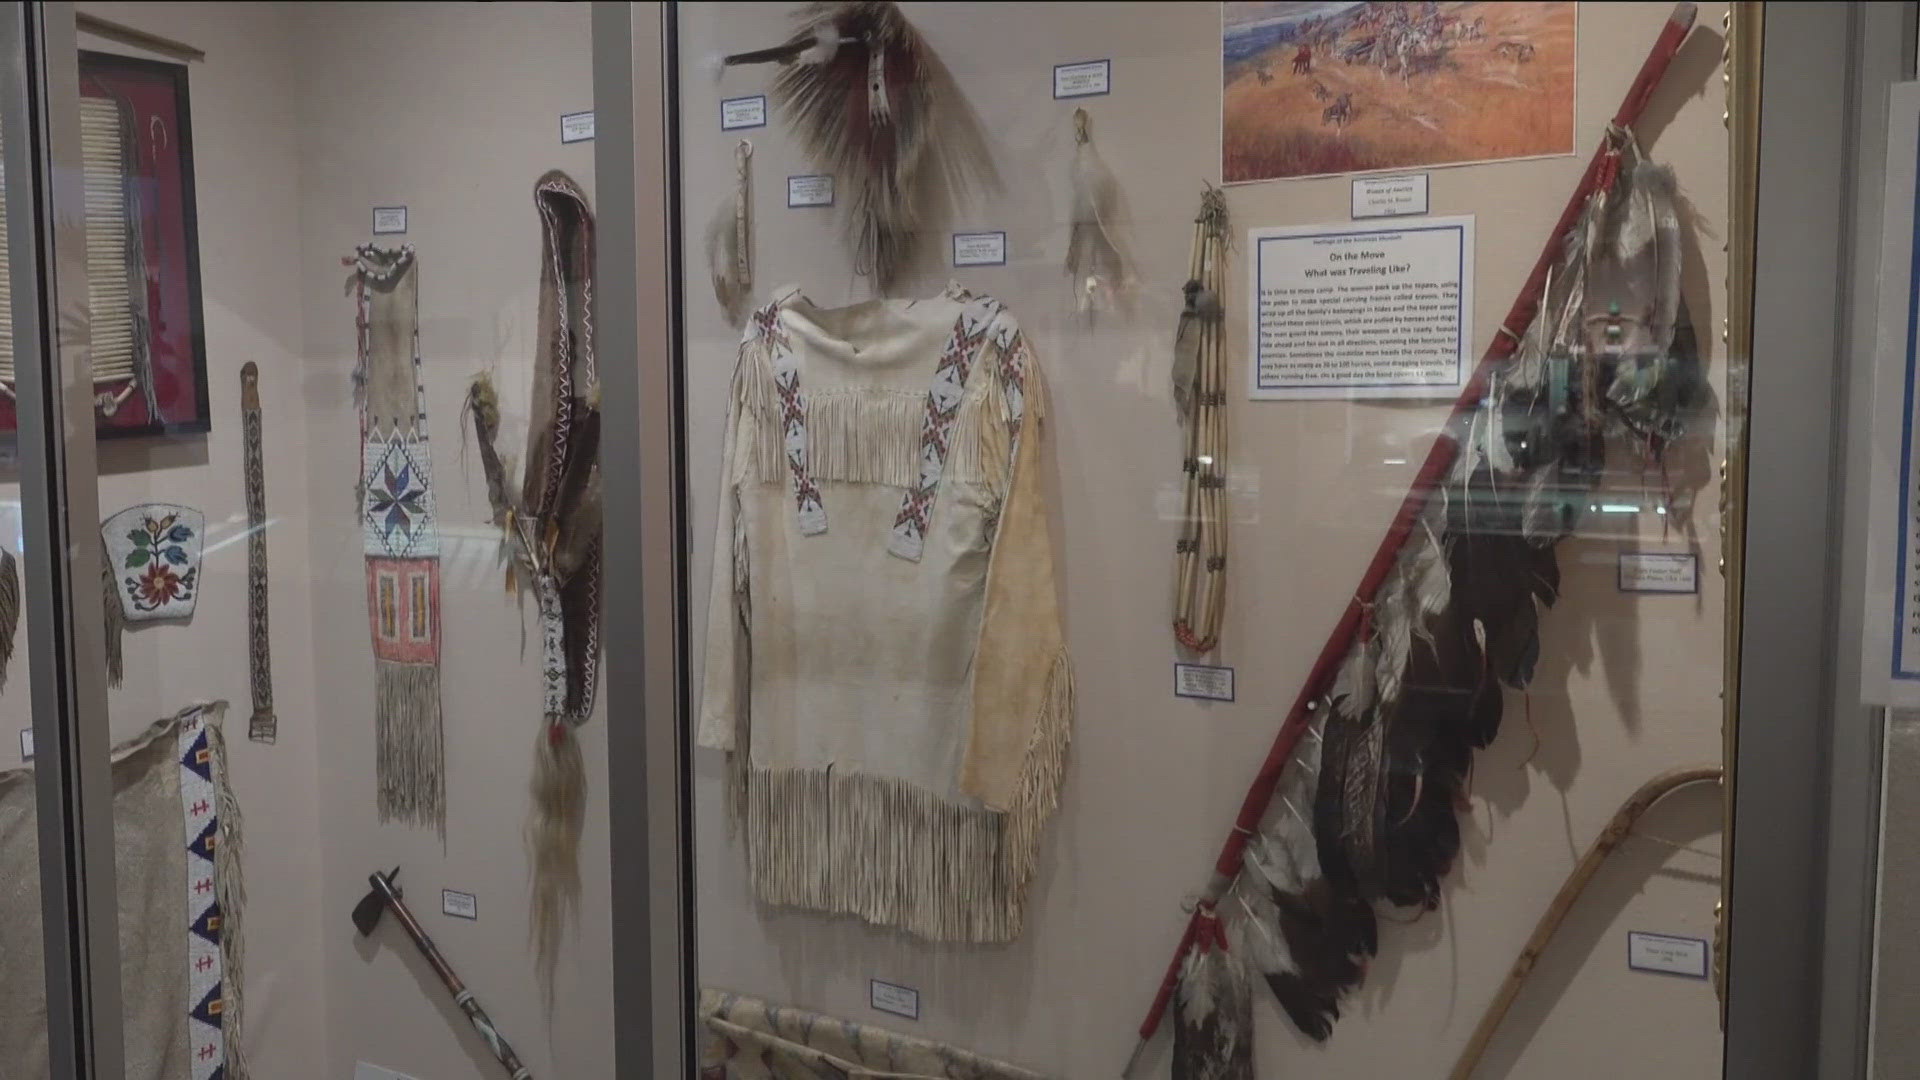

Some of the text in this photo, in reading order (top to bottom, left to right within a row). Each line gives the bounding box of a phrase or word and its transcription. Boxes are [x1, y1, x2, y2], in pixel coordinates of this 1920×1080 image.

[1330, 251, 1385, 261] On the Move
[1304, 269, 1327, 278] What
[1349, 266, 1386, 276] Traveling
[1389, 263, 1411, 273] Like?
